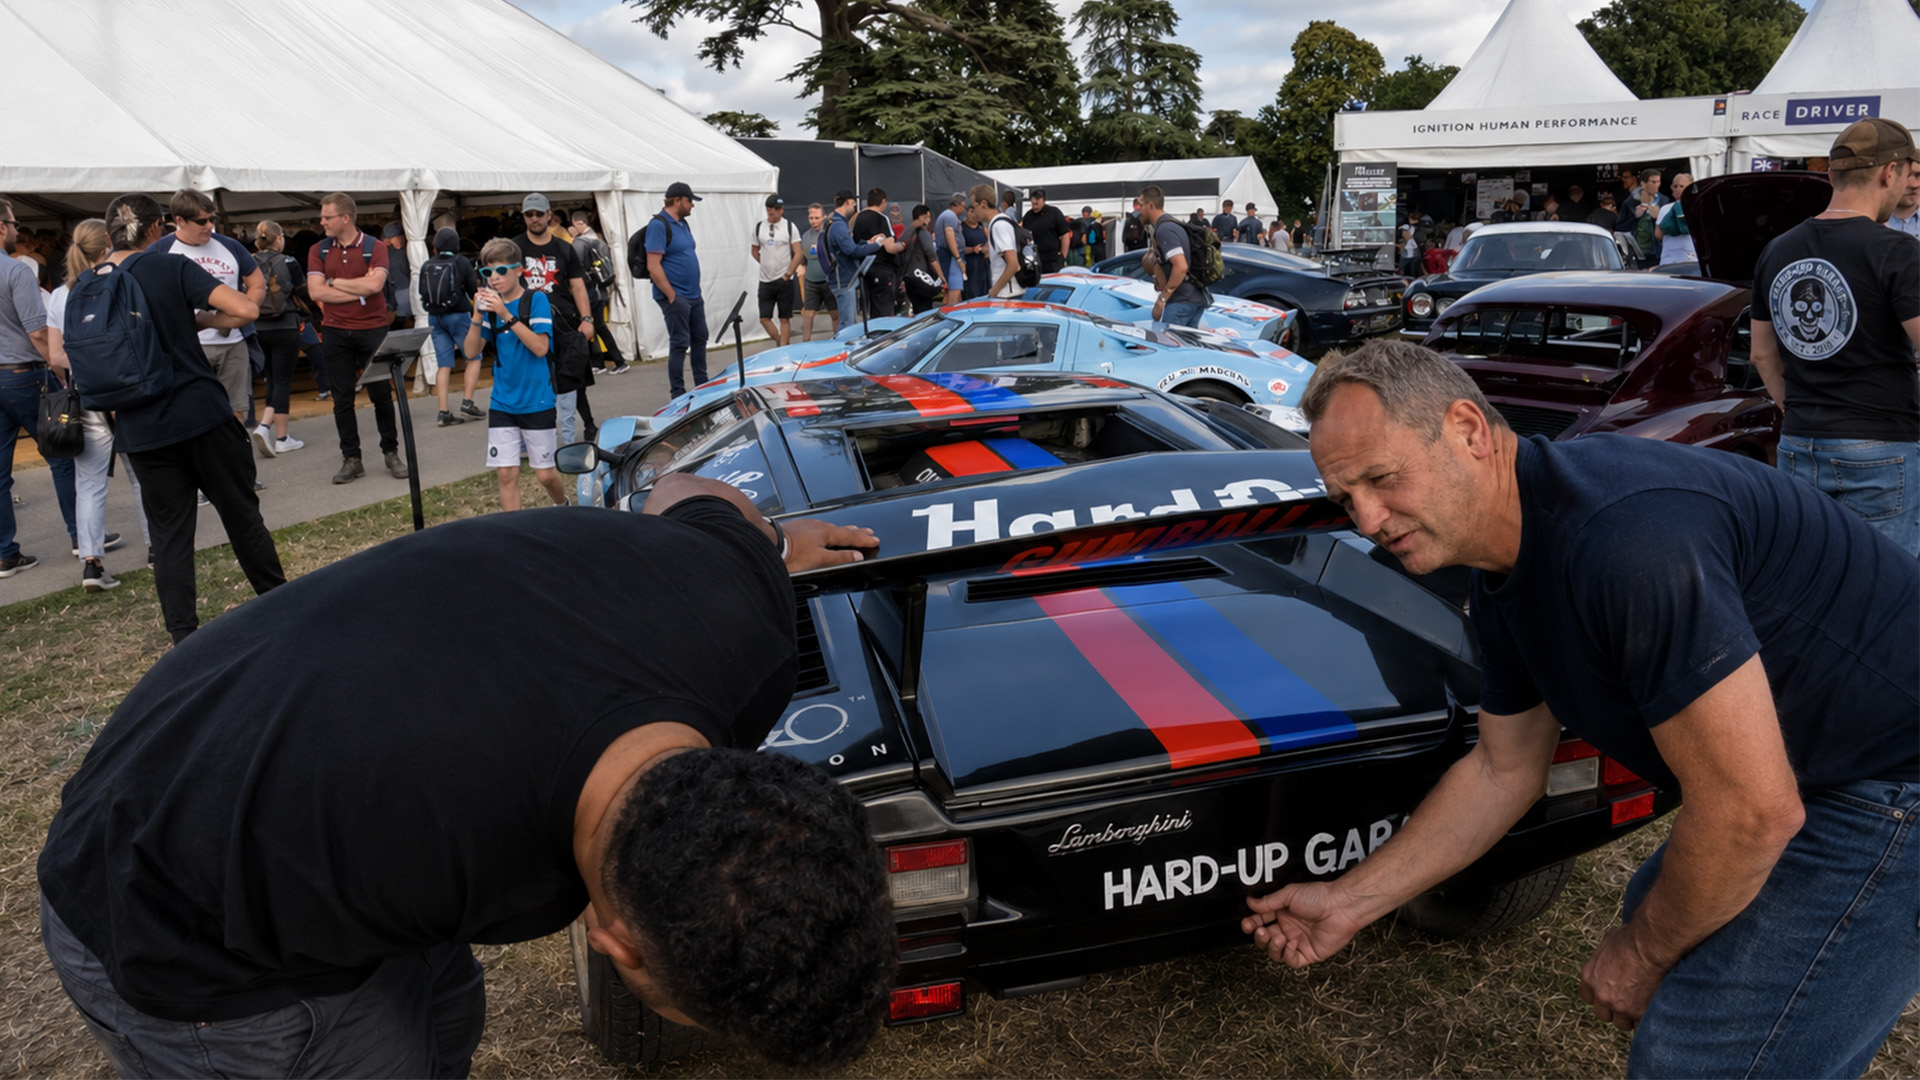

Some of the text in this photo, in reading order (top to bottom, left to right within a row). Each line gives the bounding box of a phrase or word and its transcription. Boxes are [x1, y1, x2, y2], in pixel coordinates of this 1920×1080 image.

[1412, 116, 1638, 134] IGNITION HUMAN PERFORMANCE
[1741, 104, 1869, 121] RACE DRIVER
[1048, 809, 1194, 856] Lamborghini
[1103, 841, 1290, 911] HARD-UP
